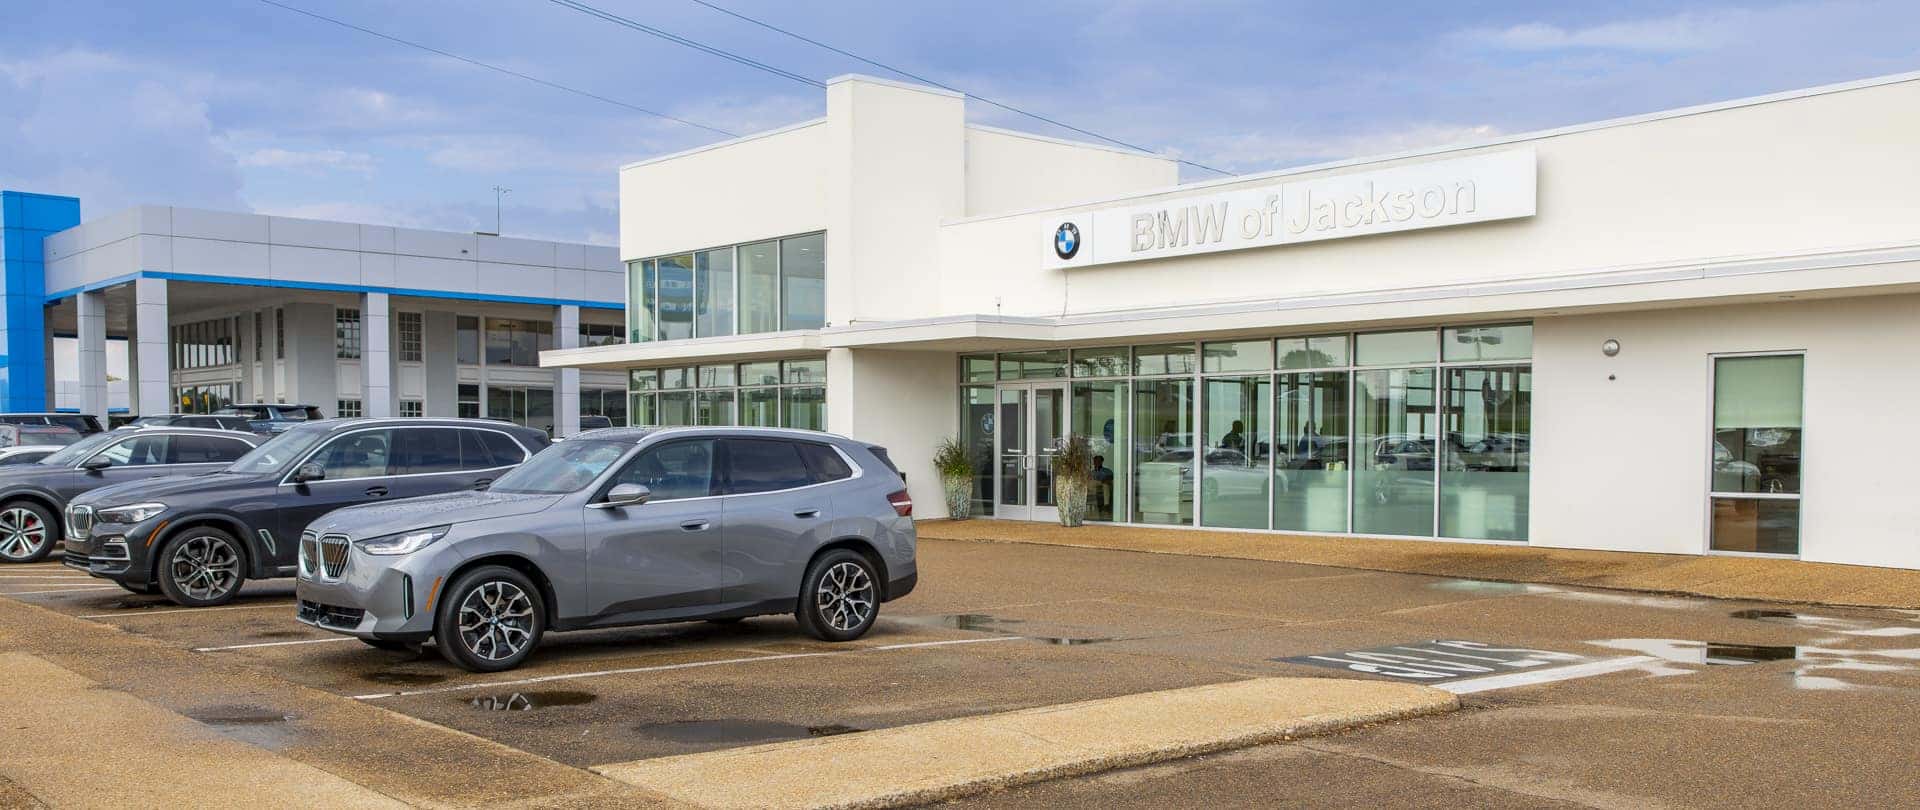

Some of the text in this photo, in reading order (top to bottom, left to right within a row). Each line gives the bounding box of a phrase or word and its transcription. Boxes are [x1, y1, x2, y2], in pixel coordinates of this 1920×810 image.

[1131, 177, 1477, 252] BMW of Jackson
